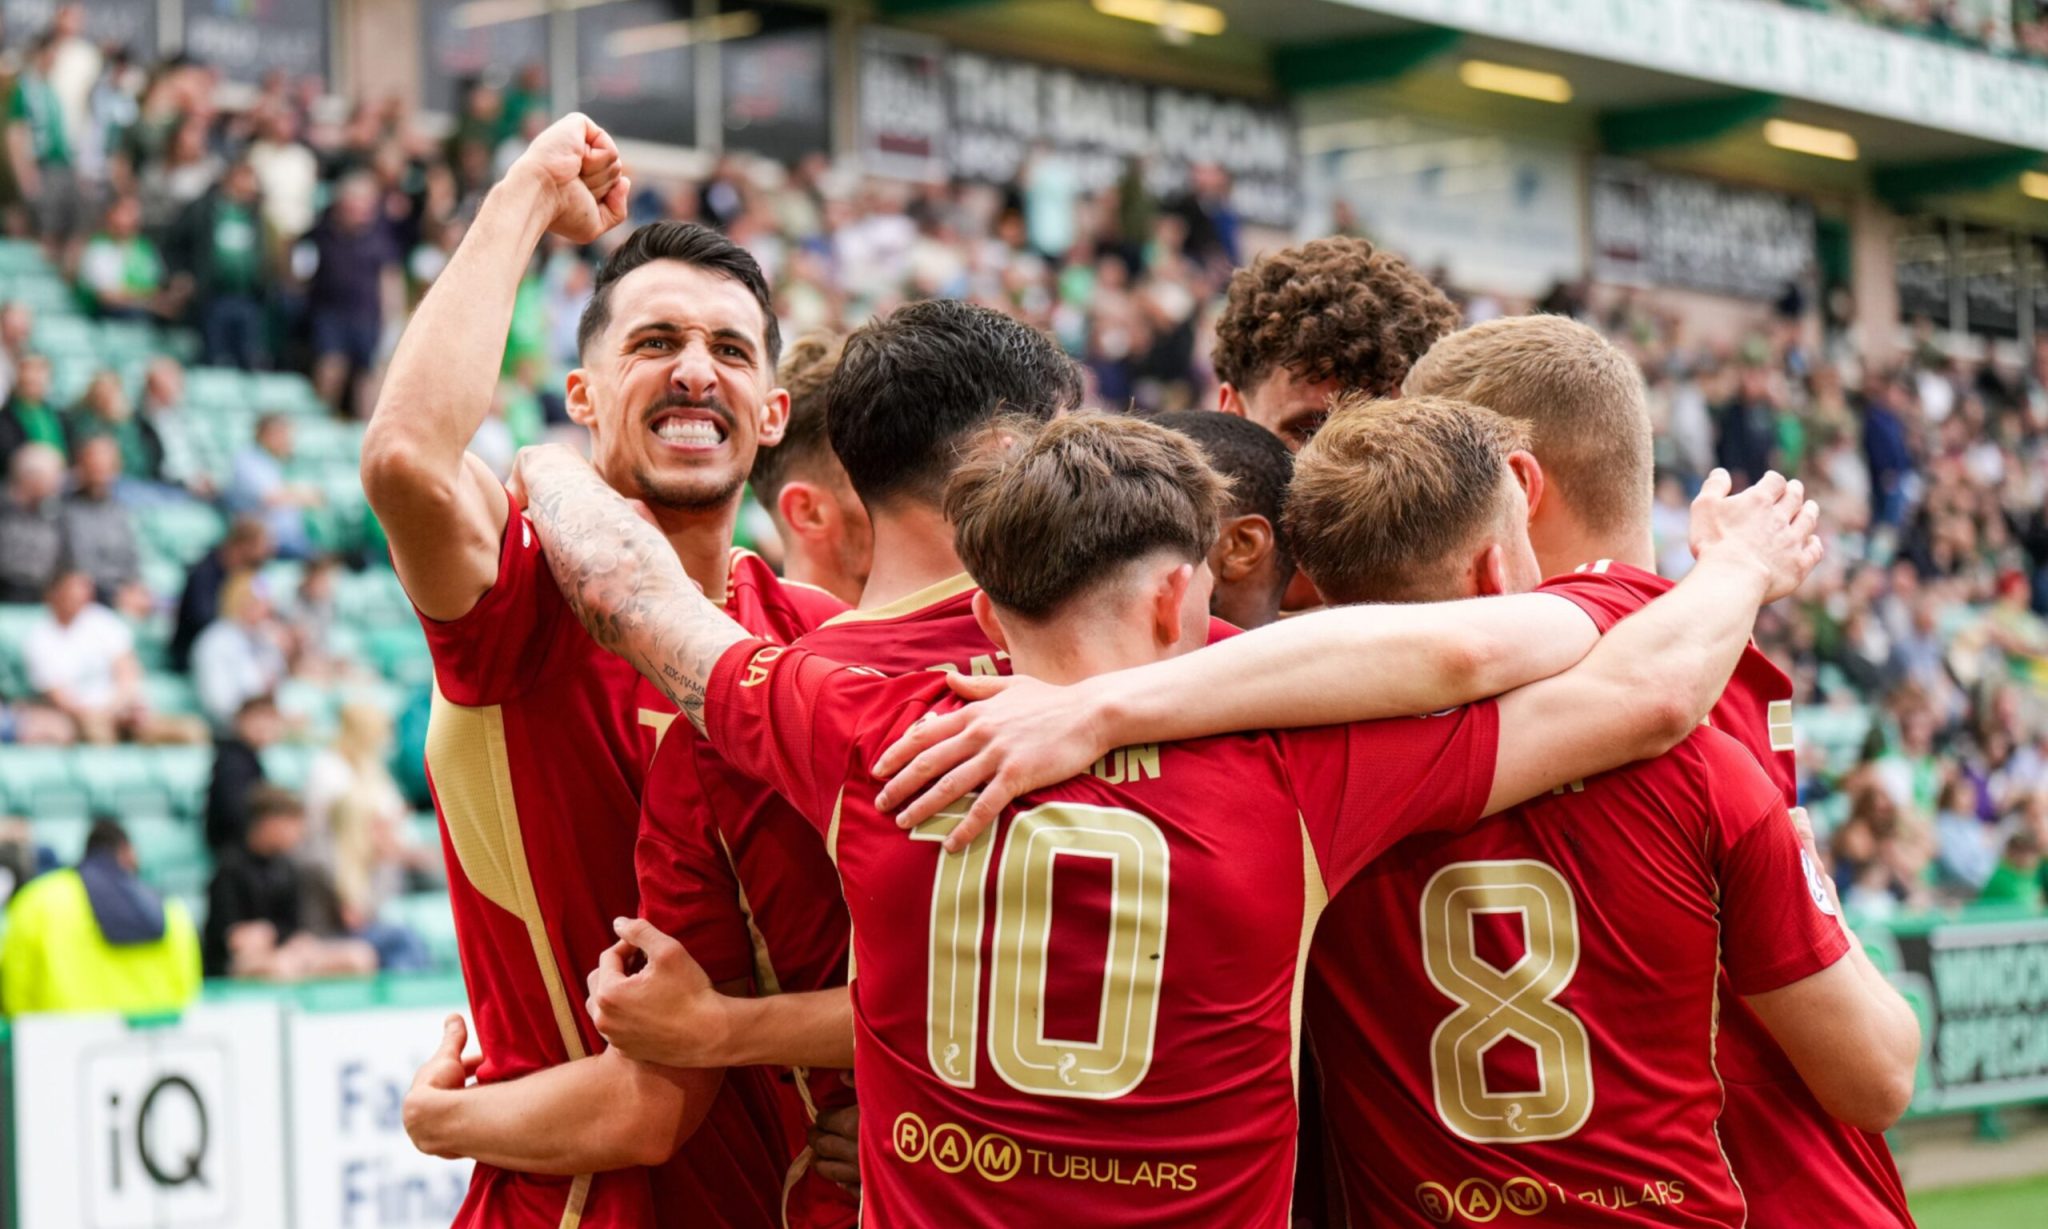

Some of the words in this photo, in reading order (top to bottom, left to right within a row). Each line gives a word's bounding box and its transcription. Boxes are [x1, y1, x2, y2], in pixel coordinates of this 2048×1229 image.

[909, 793, 1170, 1100] 10
[1419, 858, 1594, 1143] 8
[106, 1073, 213, 1193] iQ
[896, 1117, 1018, 1178] RAM
[1027, 1149, 1198, 1191] TUBULARS
[1418, 1180, 1543, 1220] RAM
